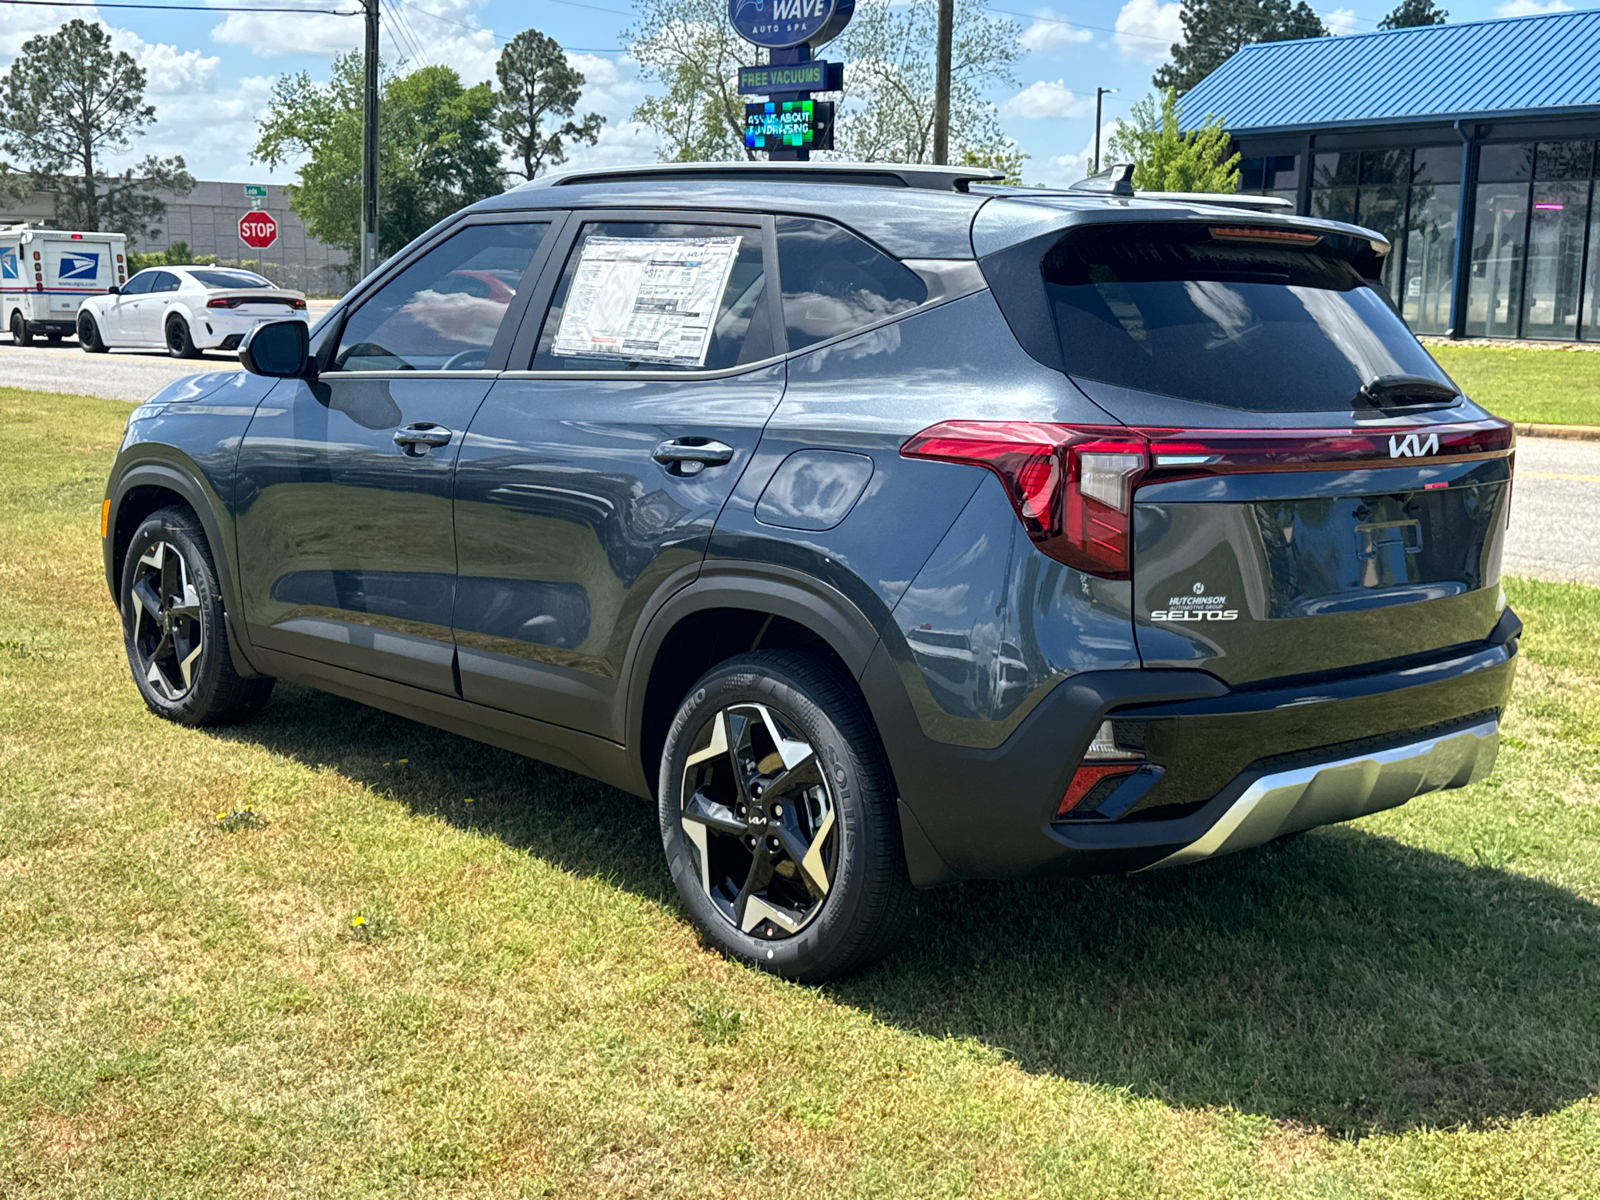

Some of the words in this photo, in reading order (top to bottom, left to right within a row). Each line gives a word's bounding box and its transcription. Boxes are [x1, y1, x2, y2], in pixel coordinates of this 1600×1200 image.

[773, 0, 825, 20] WAVE
[752, 25, 779, 34] AUTO
[786, 22, 807, 32] SPA
[741, 72, 768, 87] FREE
[770, 67, 820, 85] VACUUMS
[780, 112, 810, 123] ABOUT
[242, 222, 275, 237] STOP
[1389, 433, 1439, 458] KIA
[1169, 596, 1226, 605] HUTCHINSON
[1150, 610, 1239, 621] SELTOS
[664, 688, 706, 761] KUMHO
[825, 743, 856, 853] SOLUS
